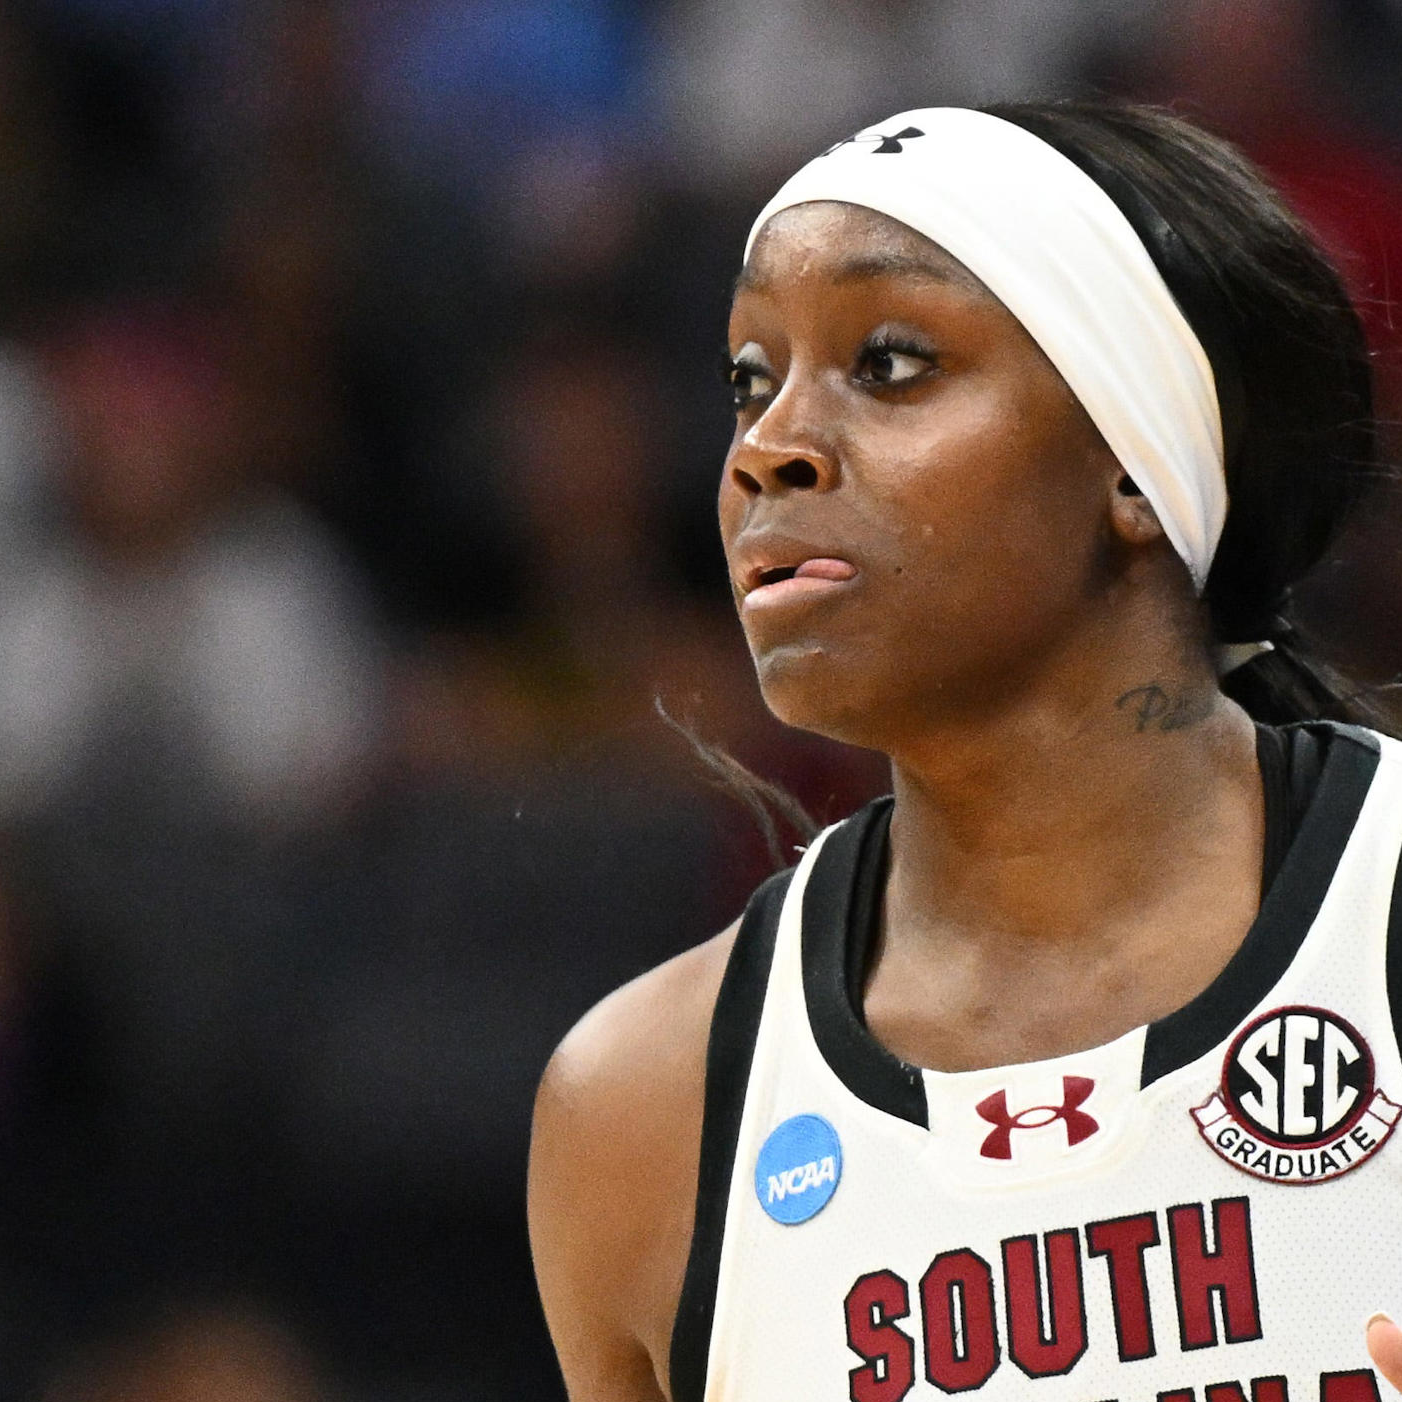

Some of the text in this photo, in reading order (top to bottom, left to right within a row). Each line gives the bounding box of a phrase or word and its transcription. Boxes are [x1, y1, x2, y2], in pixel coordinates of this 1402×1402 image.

[1237, 1014, 1360, 1136] SEC
[1216, 1125, 1377, 1177] GRADUATE
[767, 1154, 836, 1204] NCAA
